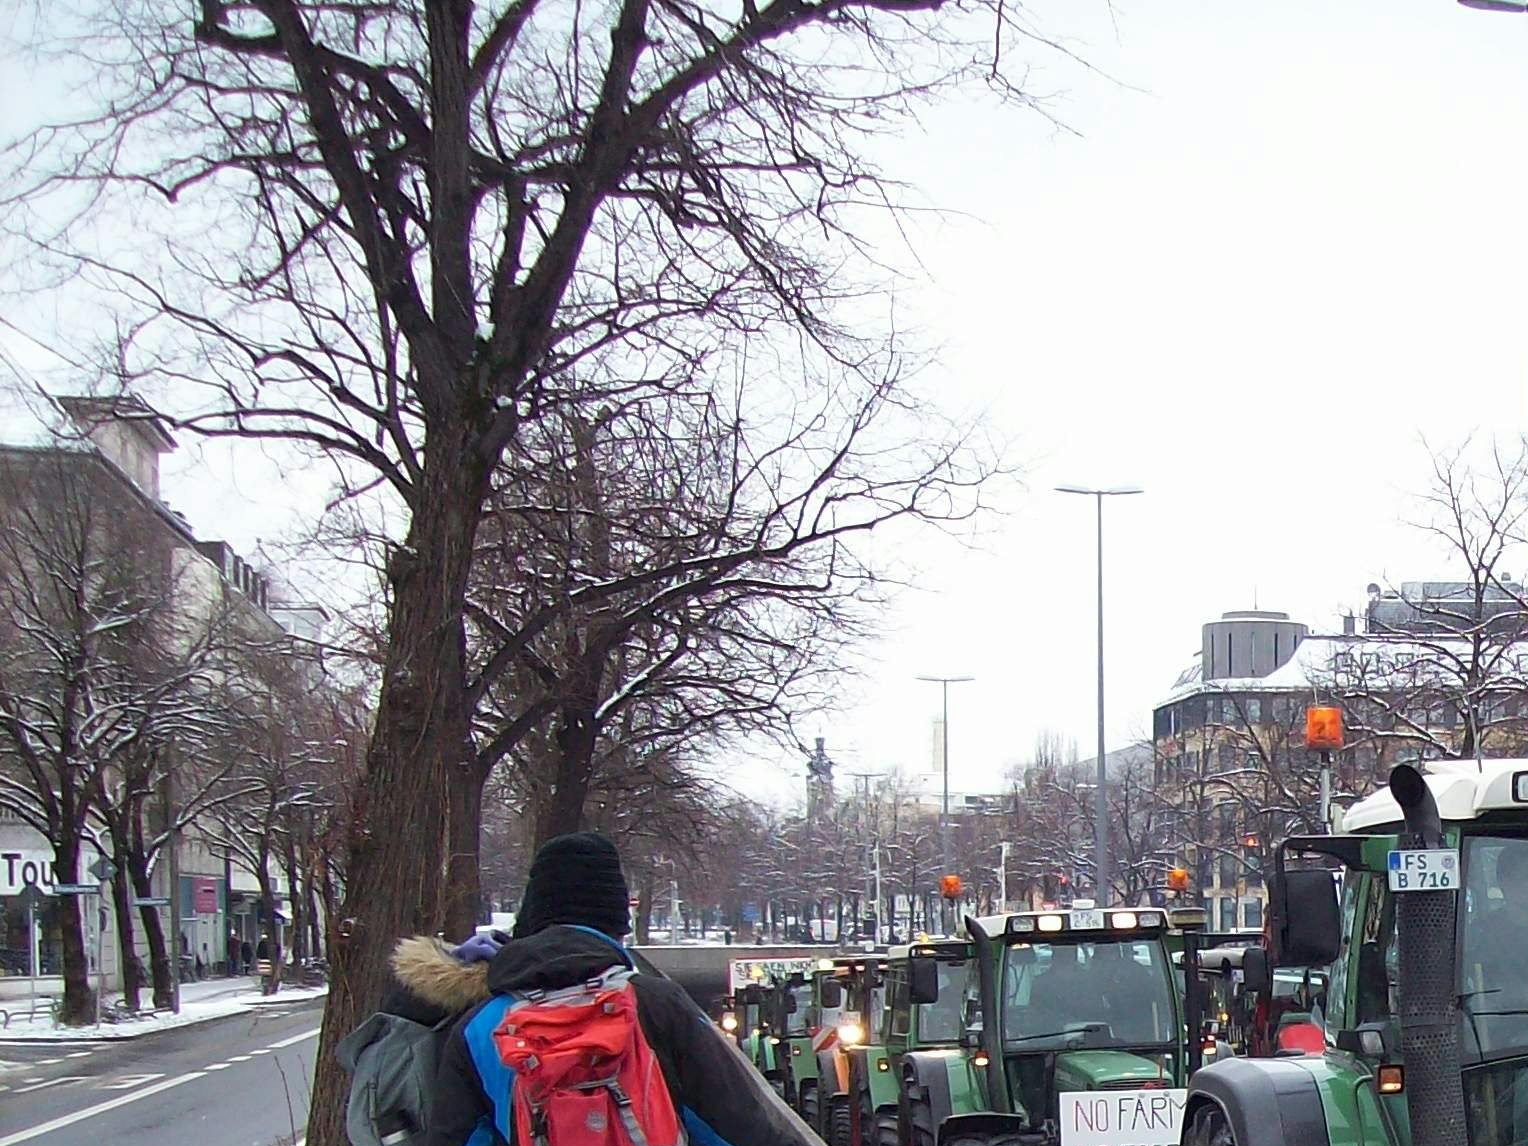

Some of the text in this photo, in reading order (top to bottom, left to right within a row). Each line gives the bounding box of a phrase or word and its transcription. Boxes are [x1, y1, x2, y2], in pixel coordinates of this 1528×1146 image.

[1405, 854, 1427, 870] FS
[1398, 872, 1450, 888] B 716
[1074, 1099, 1109, 1132] NO
